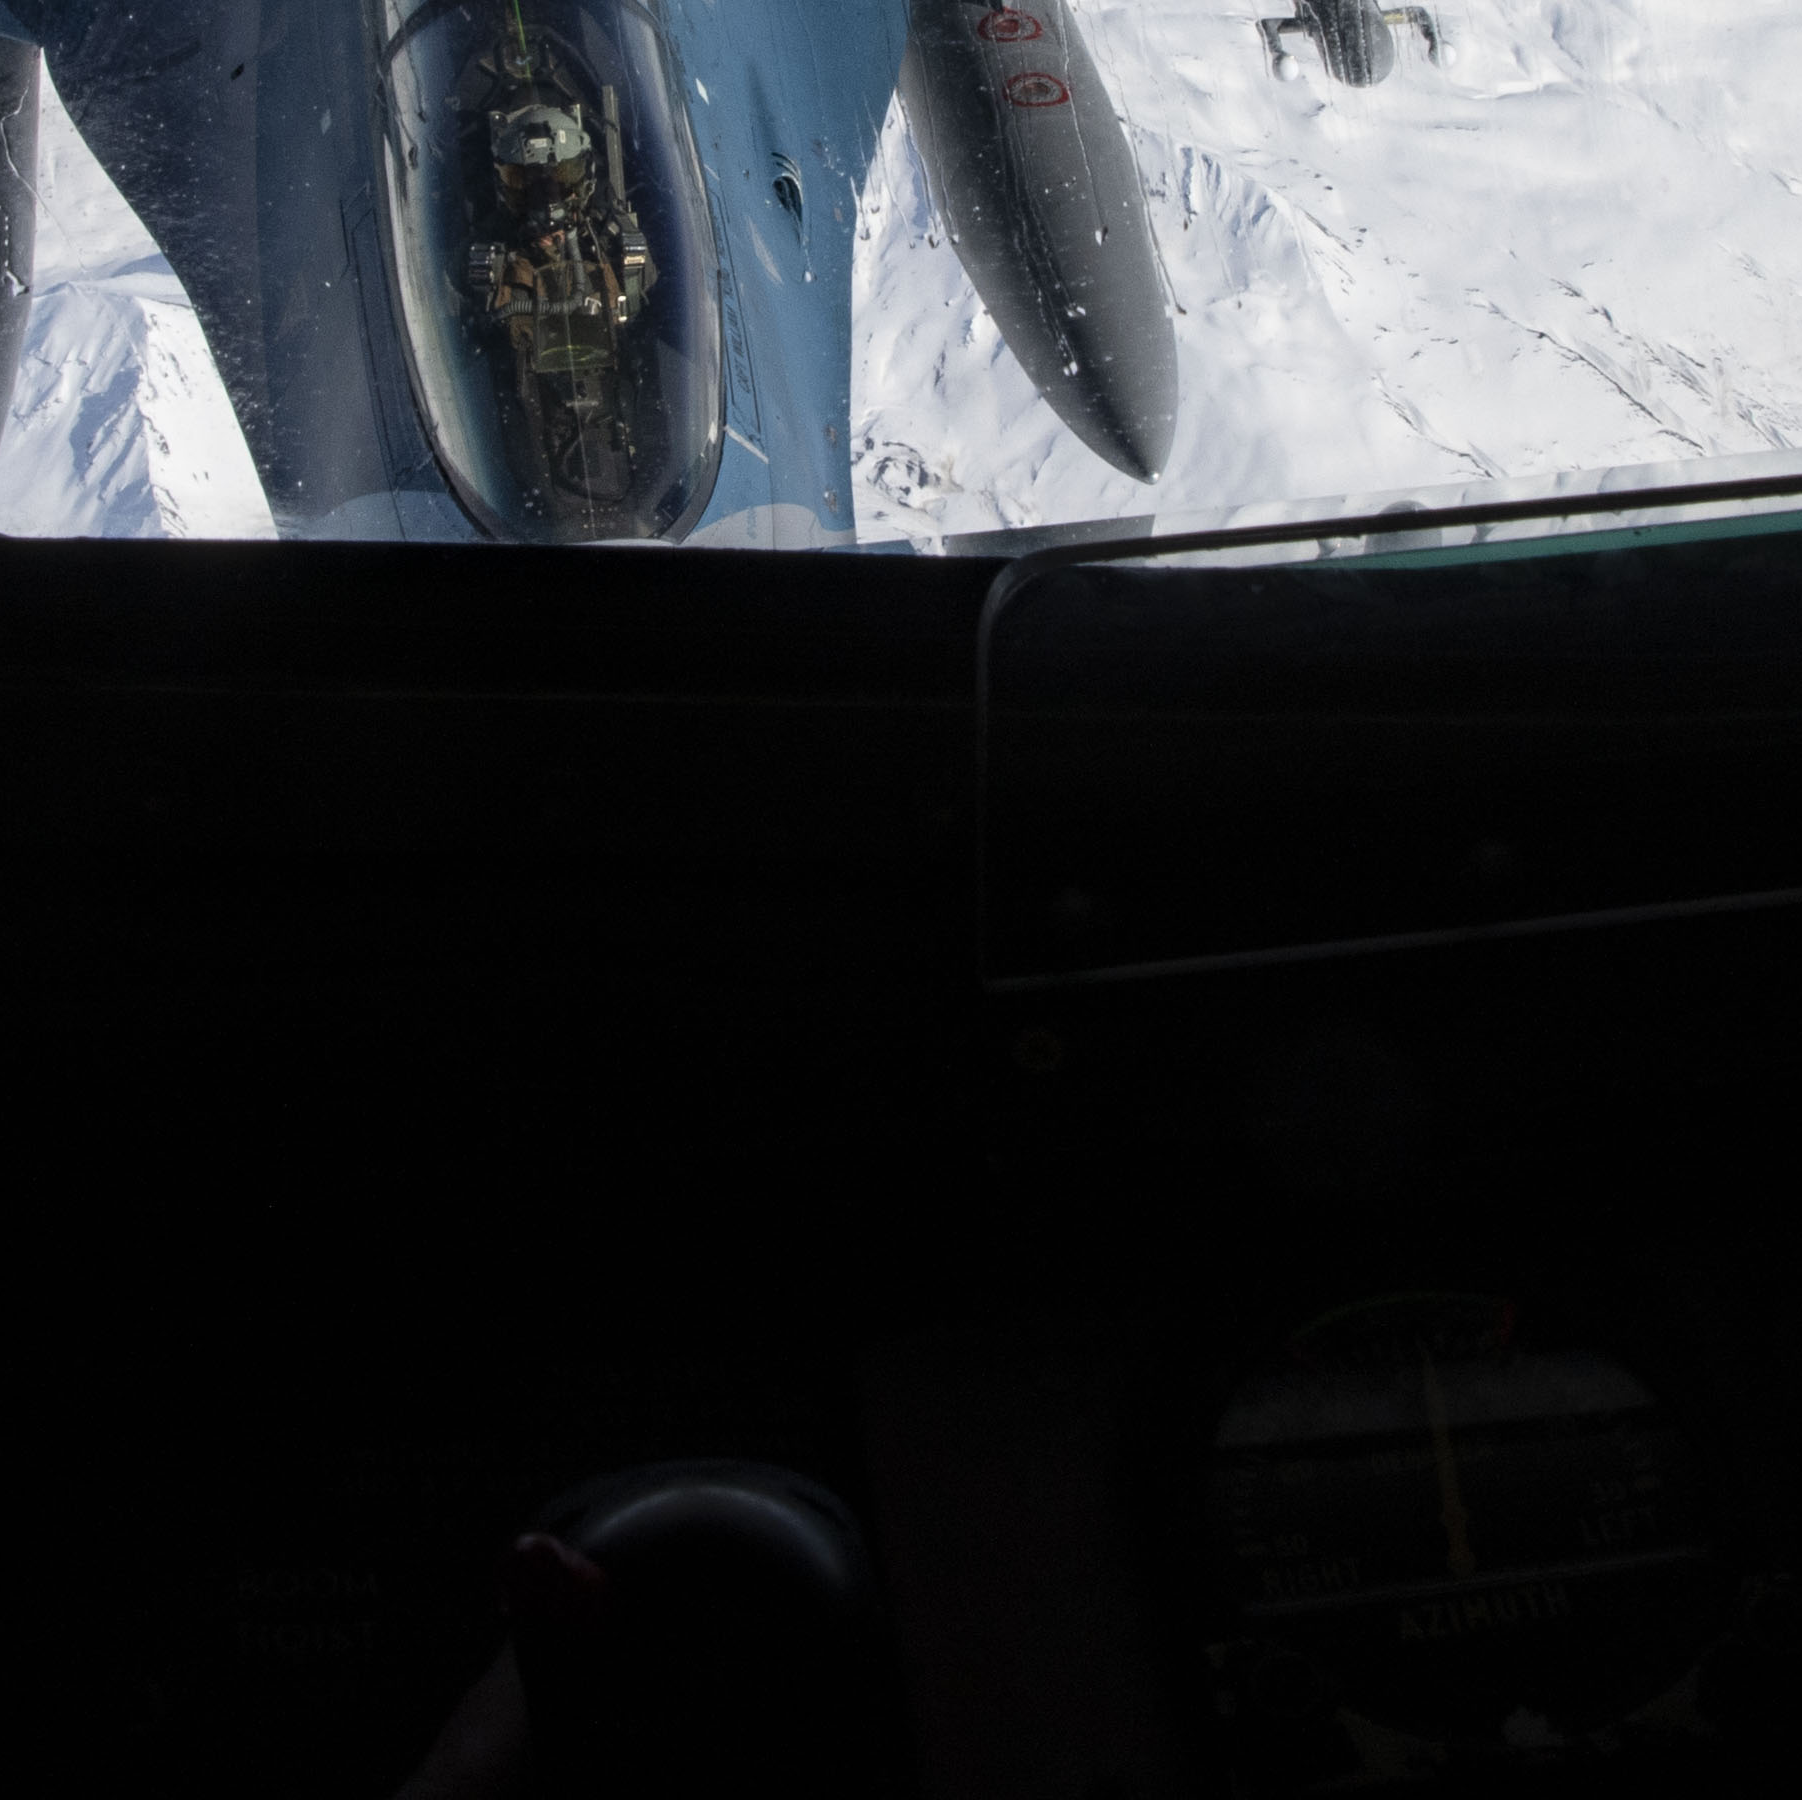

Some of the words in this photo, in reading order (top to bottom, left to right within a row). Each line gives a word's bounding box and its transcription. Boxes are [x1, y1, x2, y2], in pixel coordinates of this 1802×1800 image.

[1577, 1504, 1660, 1547] LEFT
[1260, 1556, 1361, 1598] RIGHT
[1397, 1584, 1573, 1644] AZIMUTH
